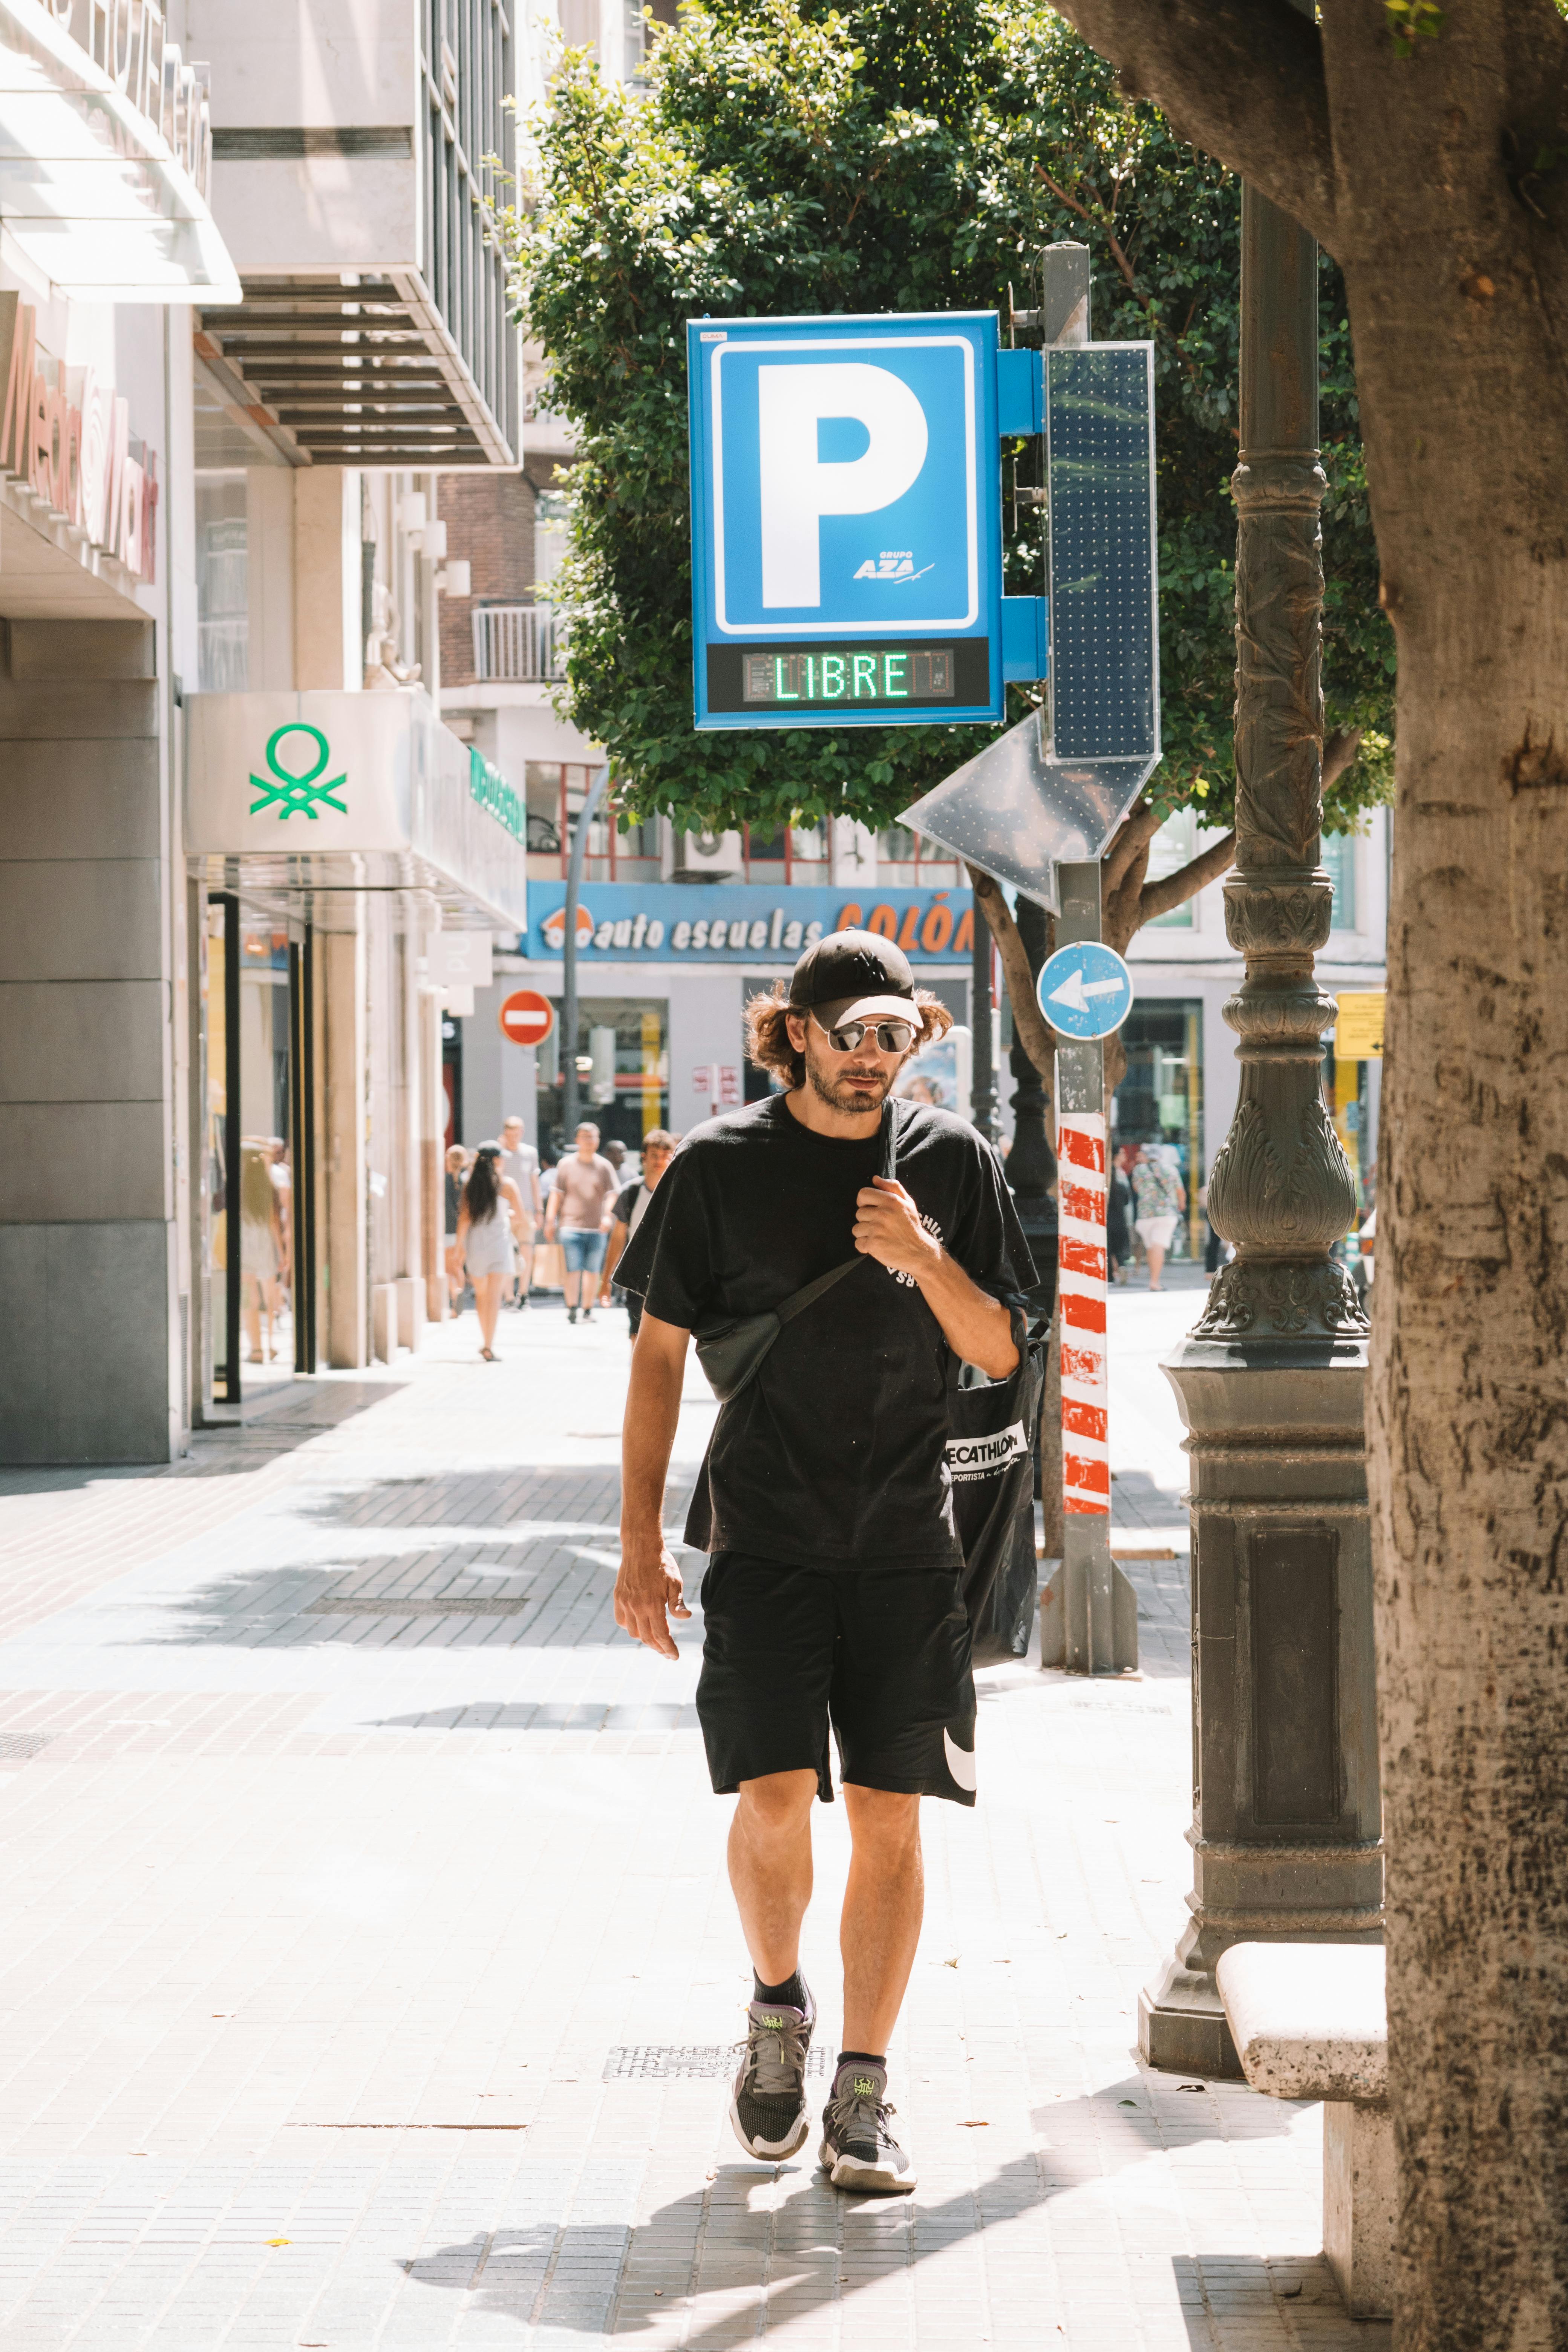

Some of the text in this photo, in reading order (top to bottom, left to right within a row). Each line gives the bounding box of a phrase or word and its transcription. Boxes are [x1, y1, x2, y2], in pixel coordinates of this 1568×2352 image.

[758, 363, 928, 608] P
[852, 559, 914, 579] AZA
[776, 654, 908, 699] LIBRE
[594, 913, 665, 950] auto
[672, 907, 823, 950] escuelas
[946, 1433, 1018, 1465] ECATHLON
[951, 1472, 985, 1482] EPORTISTA
